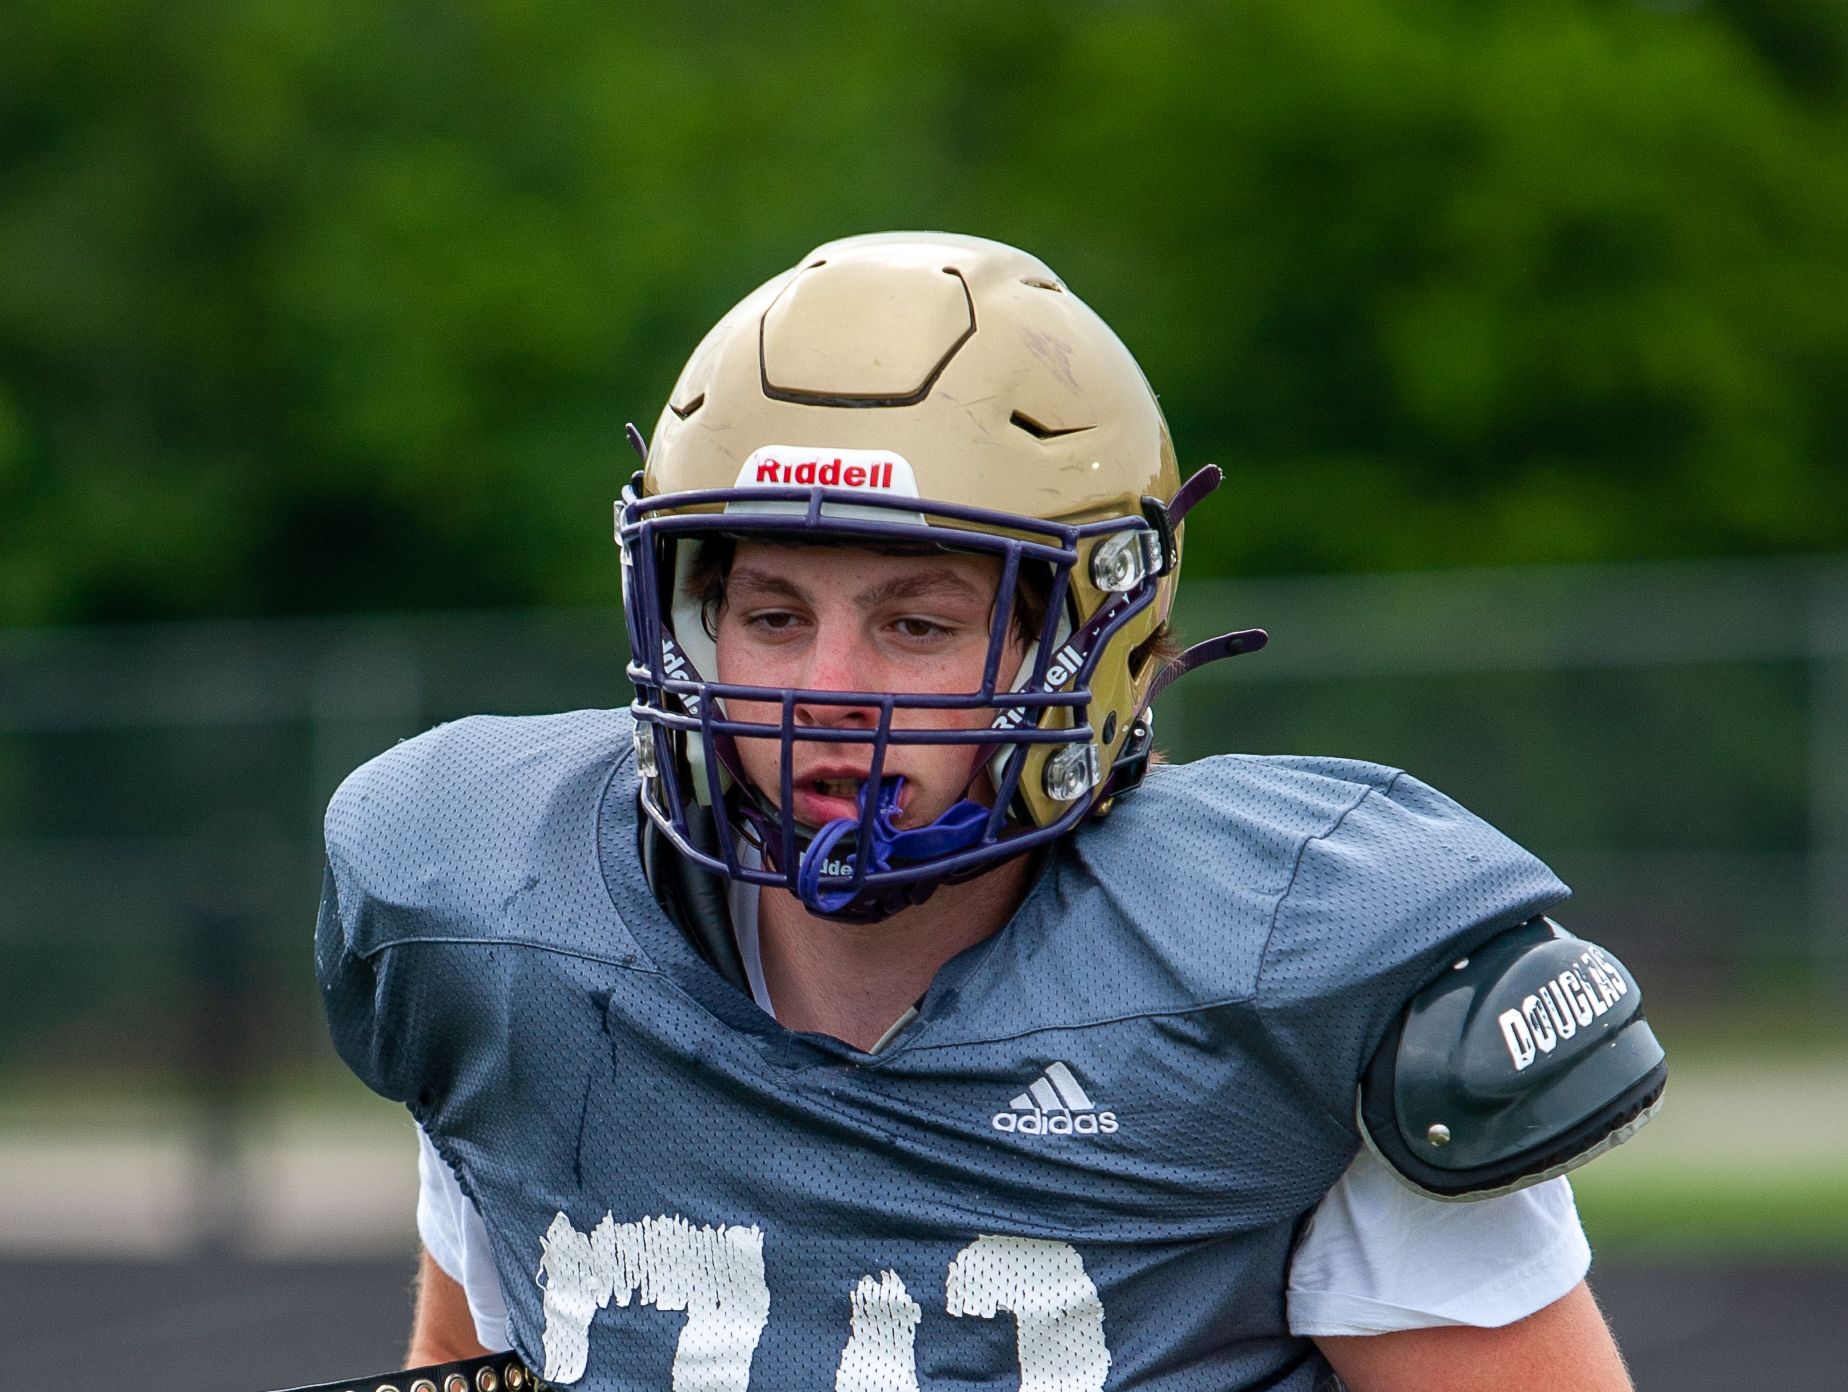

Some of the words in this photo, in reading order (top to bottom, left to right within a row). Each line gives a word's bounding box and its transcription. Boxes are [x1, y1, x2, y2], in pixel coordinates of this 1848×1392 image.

[756, 456, 893, 488] Riddell
[1498, 945, 1629, 1072] DOUGLAS
[992, 1108, 1120, 1135] adidas
